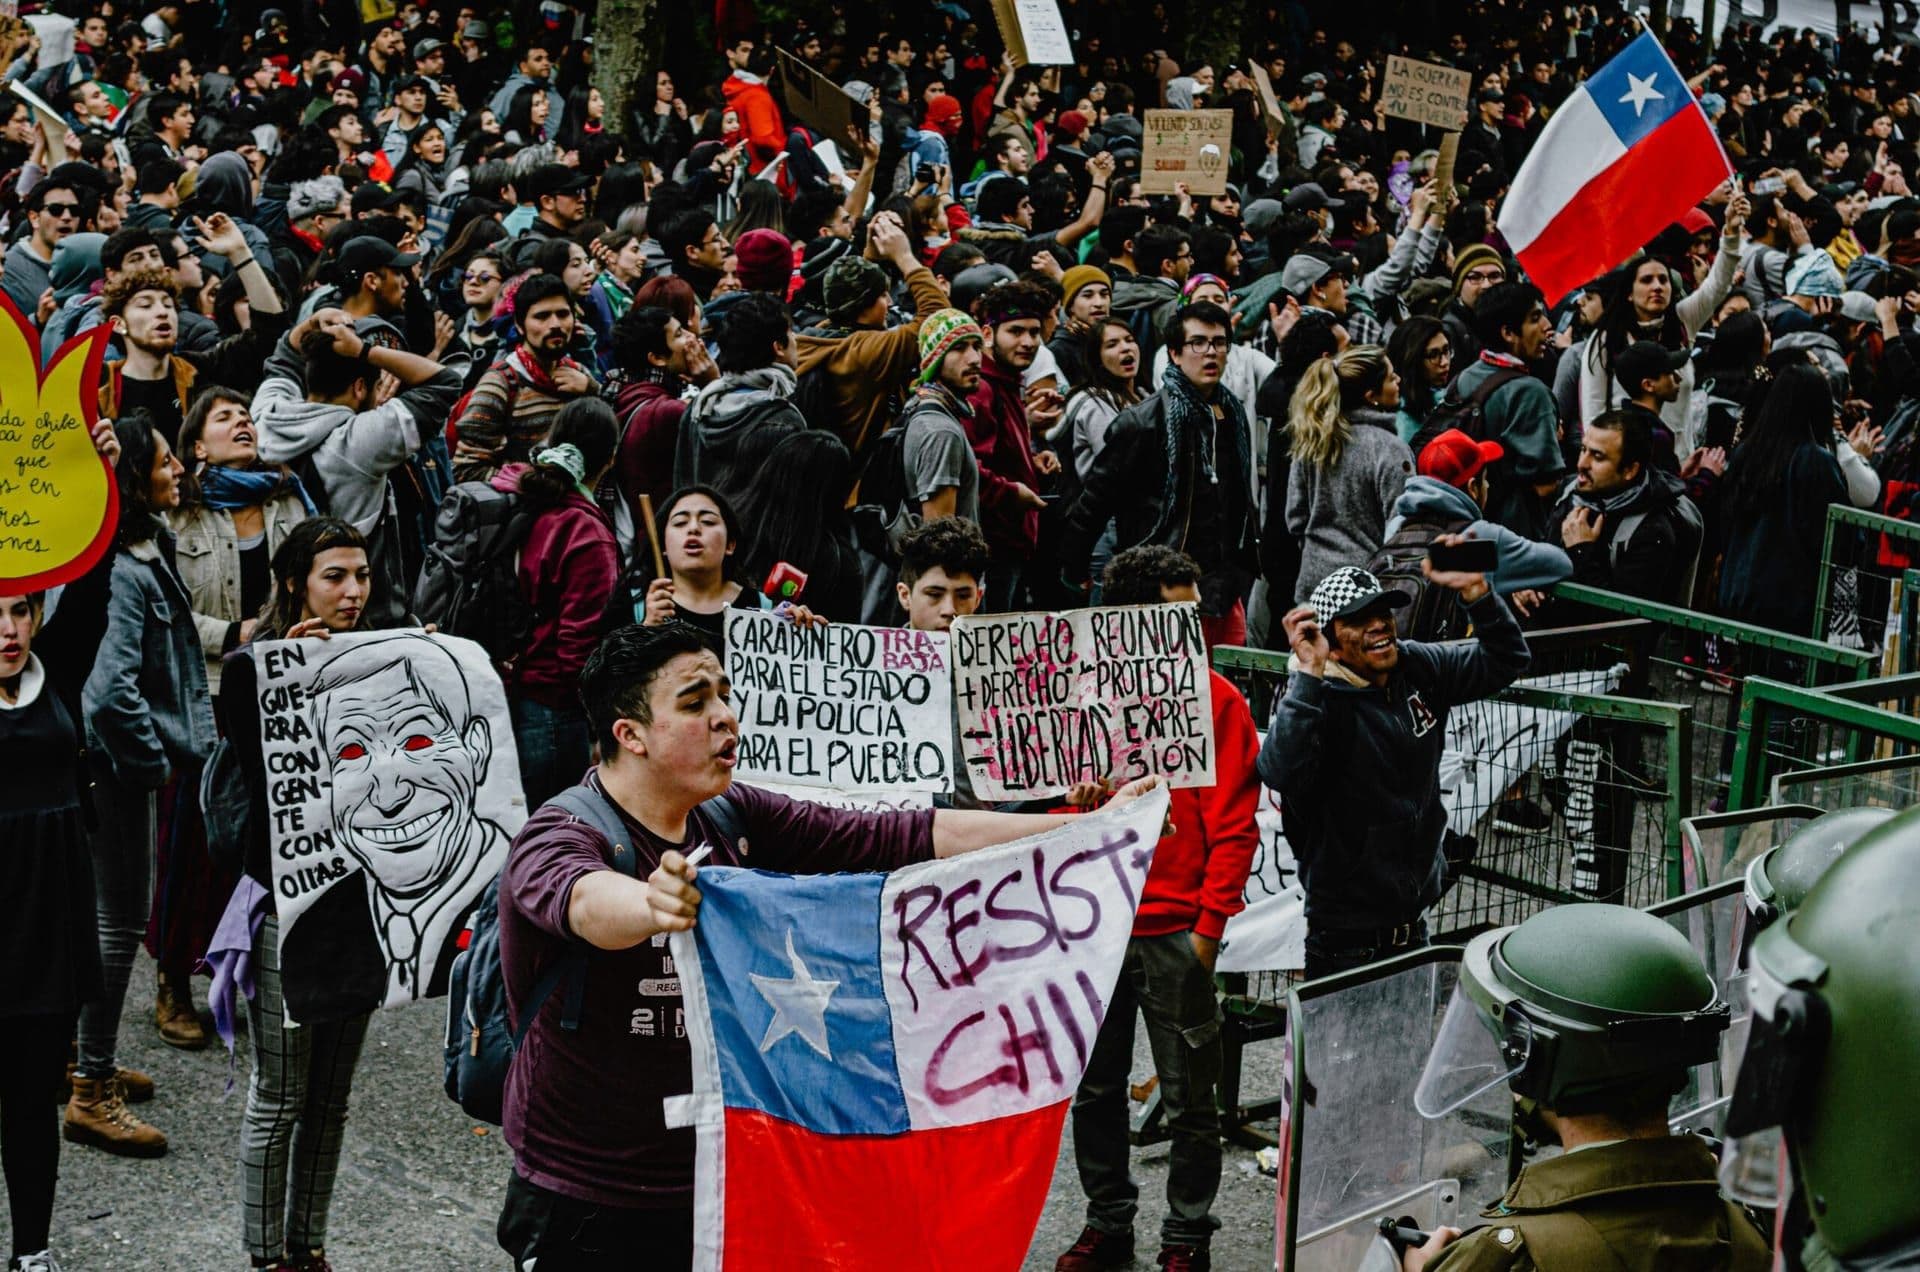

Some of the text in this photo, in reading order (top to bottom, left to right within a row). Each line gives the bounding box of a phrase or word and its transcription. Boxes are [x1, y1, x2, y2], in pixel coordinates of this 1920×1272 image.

[1392, 60, 1409, 78] LA
[1409, 87, 1424, 102] ES
[36, 412, 80, 431] chile
[32, 432, 55, 450] el
[14, 455, 51, 477] que
[30, 477, 61, 498] en
[729, 616, 946, 669] CARABINERO TRA-
[958, 618, 1073, 666] DERECHO
[265, 643, 306, 680] EN
[883, 651, 946, 673] BAJA
[731, 652, 931, 705] PARA EL ESTADO
[981, 664, 1069, 711] DERECHO
[1097, 657, 1196, 699] PROTESTA
[733, 689, 750, 723] Y
[756, 691, 789, 727] LA
[1123, 697, 1203, 744] EXPRE
[1407, 691, 1438, 738] A
[264, 714, 312, 743] RRA
[268, 751, 320, 774] CON
[736, 733, 782, 772] ARA
[788, 738, 820, 776] EL
[272, 776, 332, 807] GEN-
[273, 809, 305, 835] TE
[279, 829, 336, 860] CON
